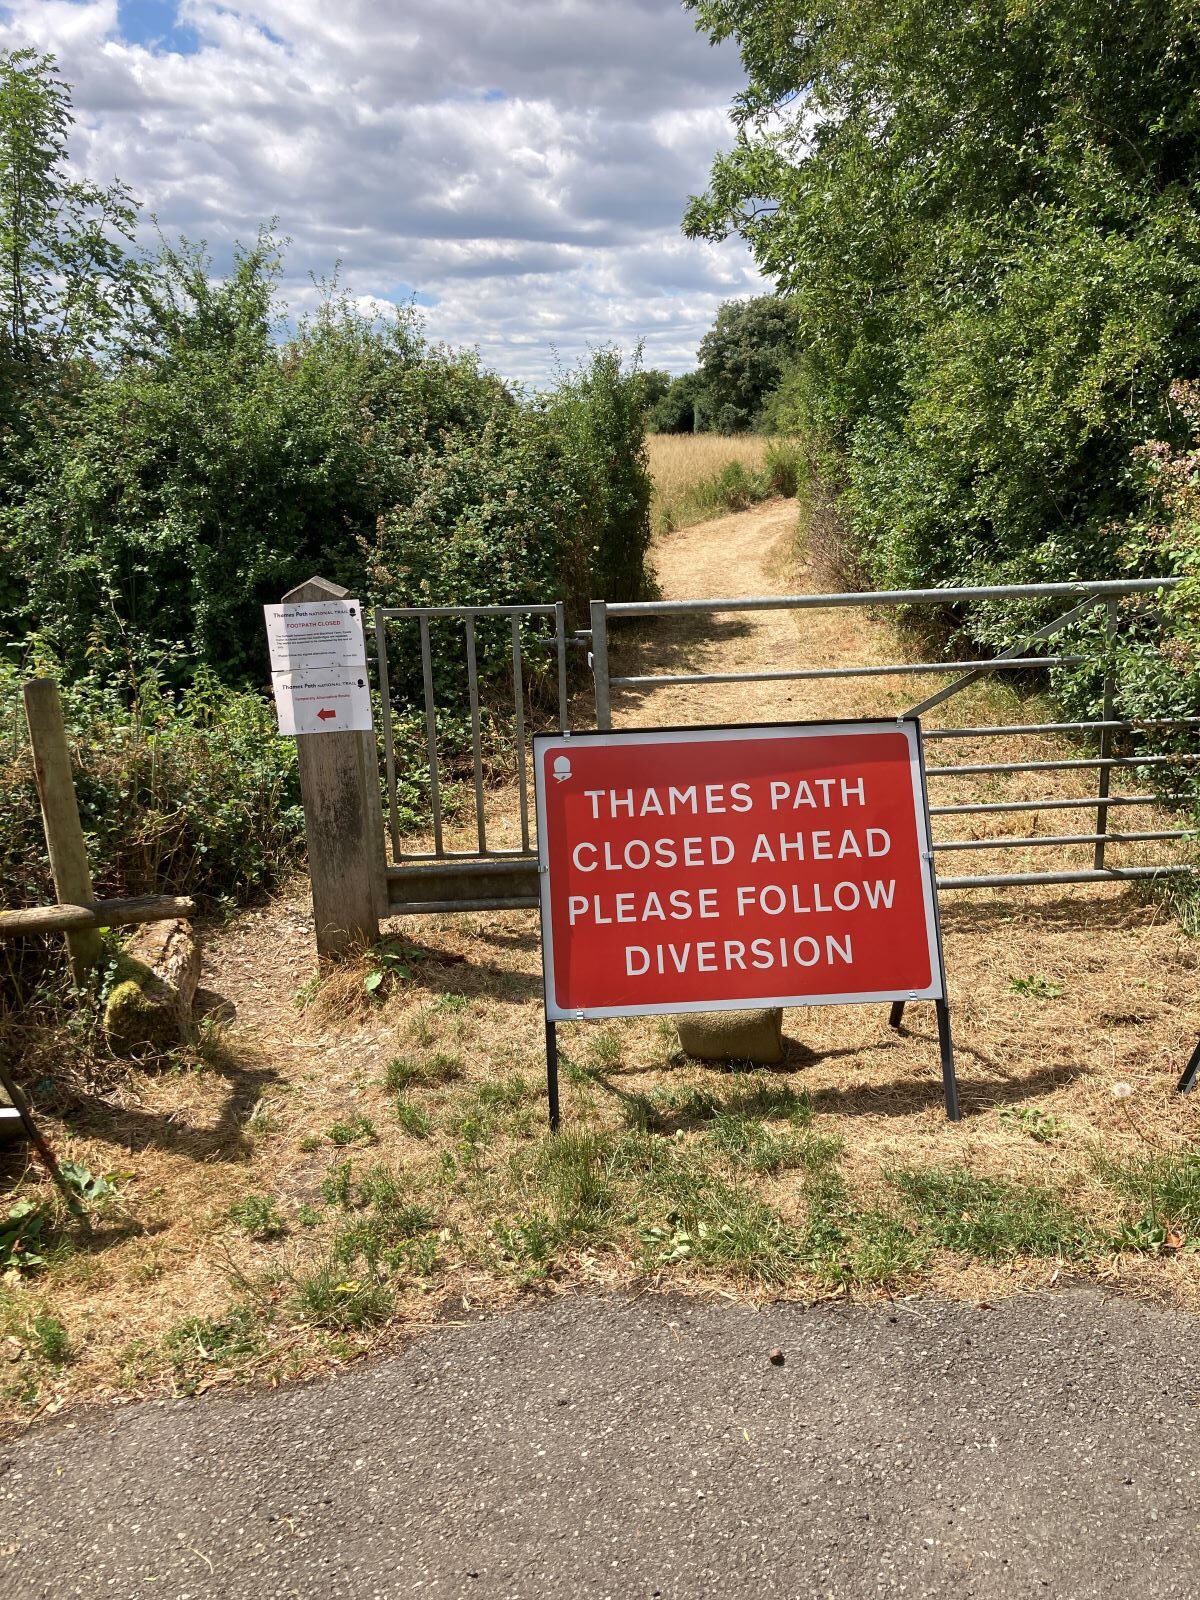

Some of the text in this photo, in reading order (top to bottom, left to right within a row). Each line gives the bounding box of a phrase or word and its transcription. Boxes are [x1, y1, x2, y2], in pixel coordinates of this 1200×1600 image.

[584, 777, 866, 819] THAMES PATH
[572, 828, 892, 873] CLOSED AHEAD
[568, 879, 896, 926] PLEASE FOLLOW
[624, 934, 854, 976] DIVERSION
